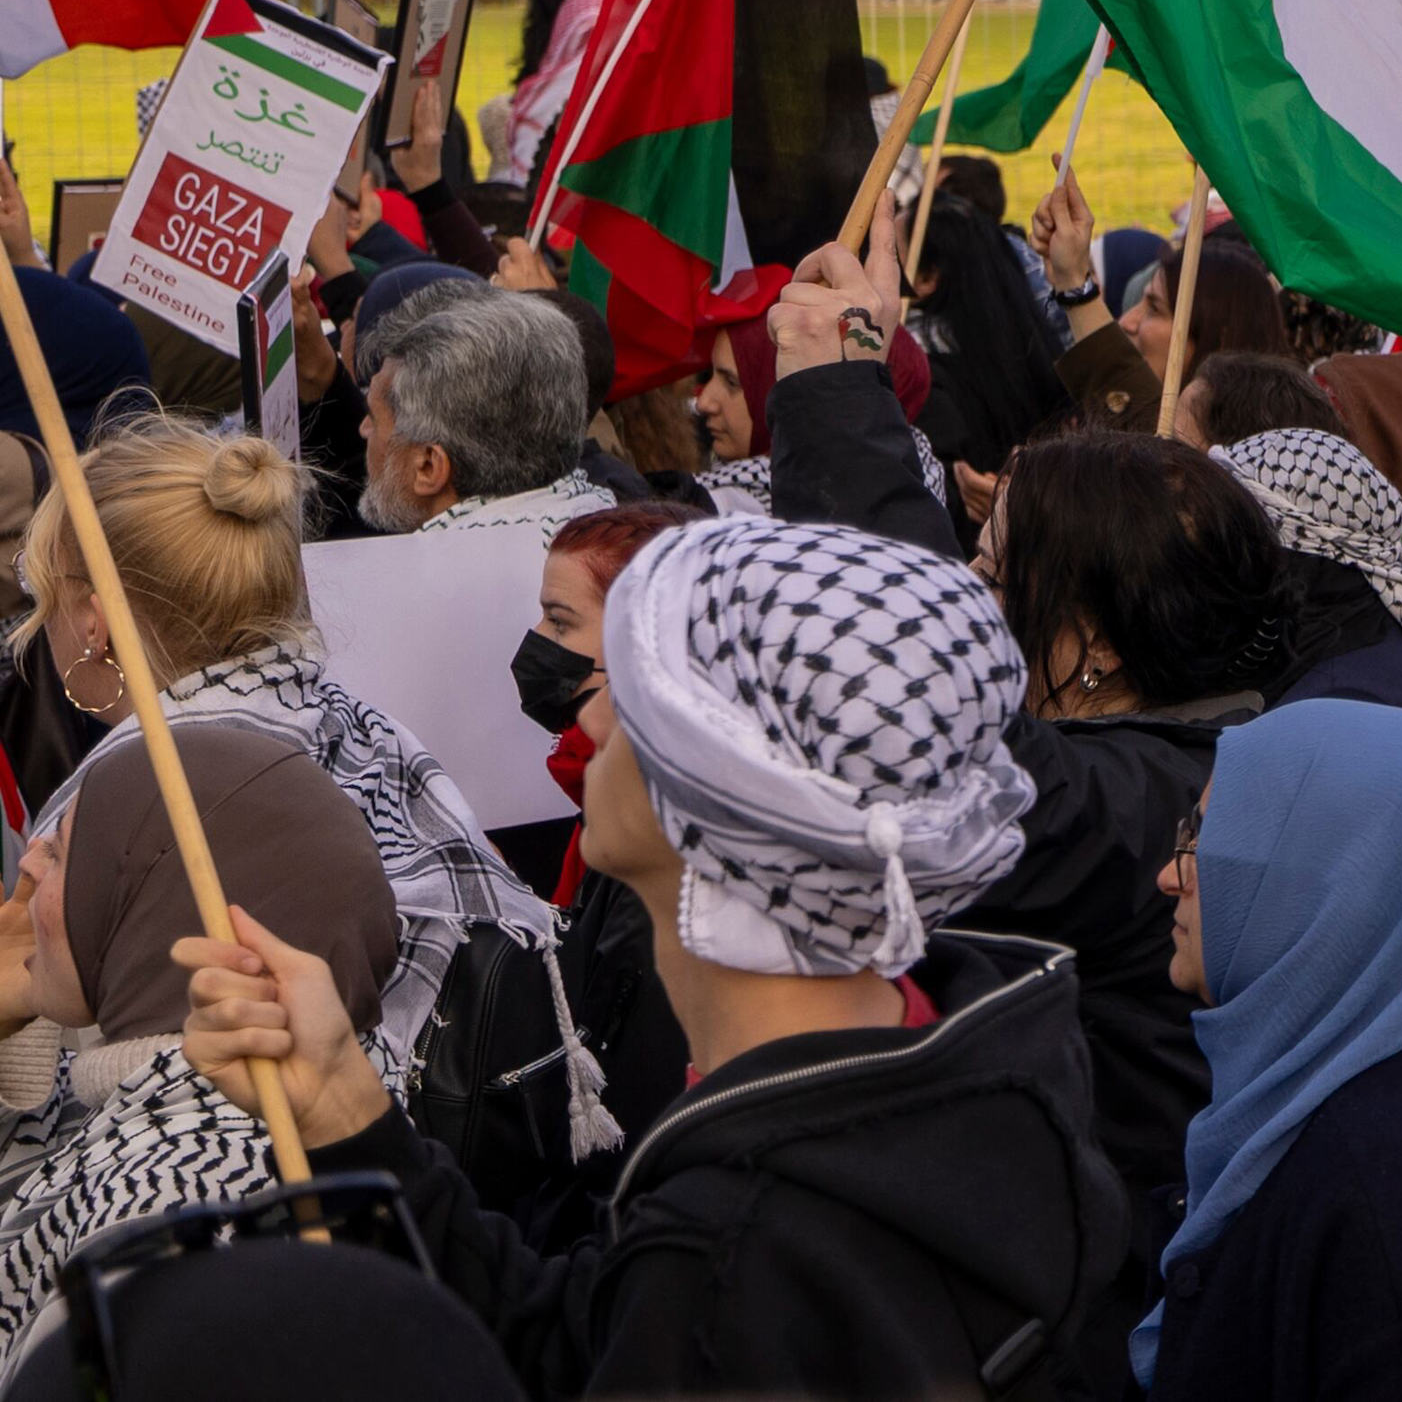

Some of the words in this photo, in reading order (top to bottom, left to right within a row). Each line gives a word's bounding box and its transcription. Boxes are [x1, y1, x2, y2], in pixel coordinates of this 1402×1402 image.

[213, 65, 315, 137] غزة
[196, 130, 285, 174] تنتصر
[174, 172, 264, 246] GAZA
[129, 254, 177, 287] Free
[160, 214, 258, 285] SIEGT
[122, 272, 226, 333] Palestine
